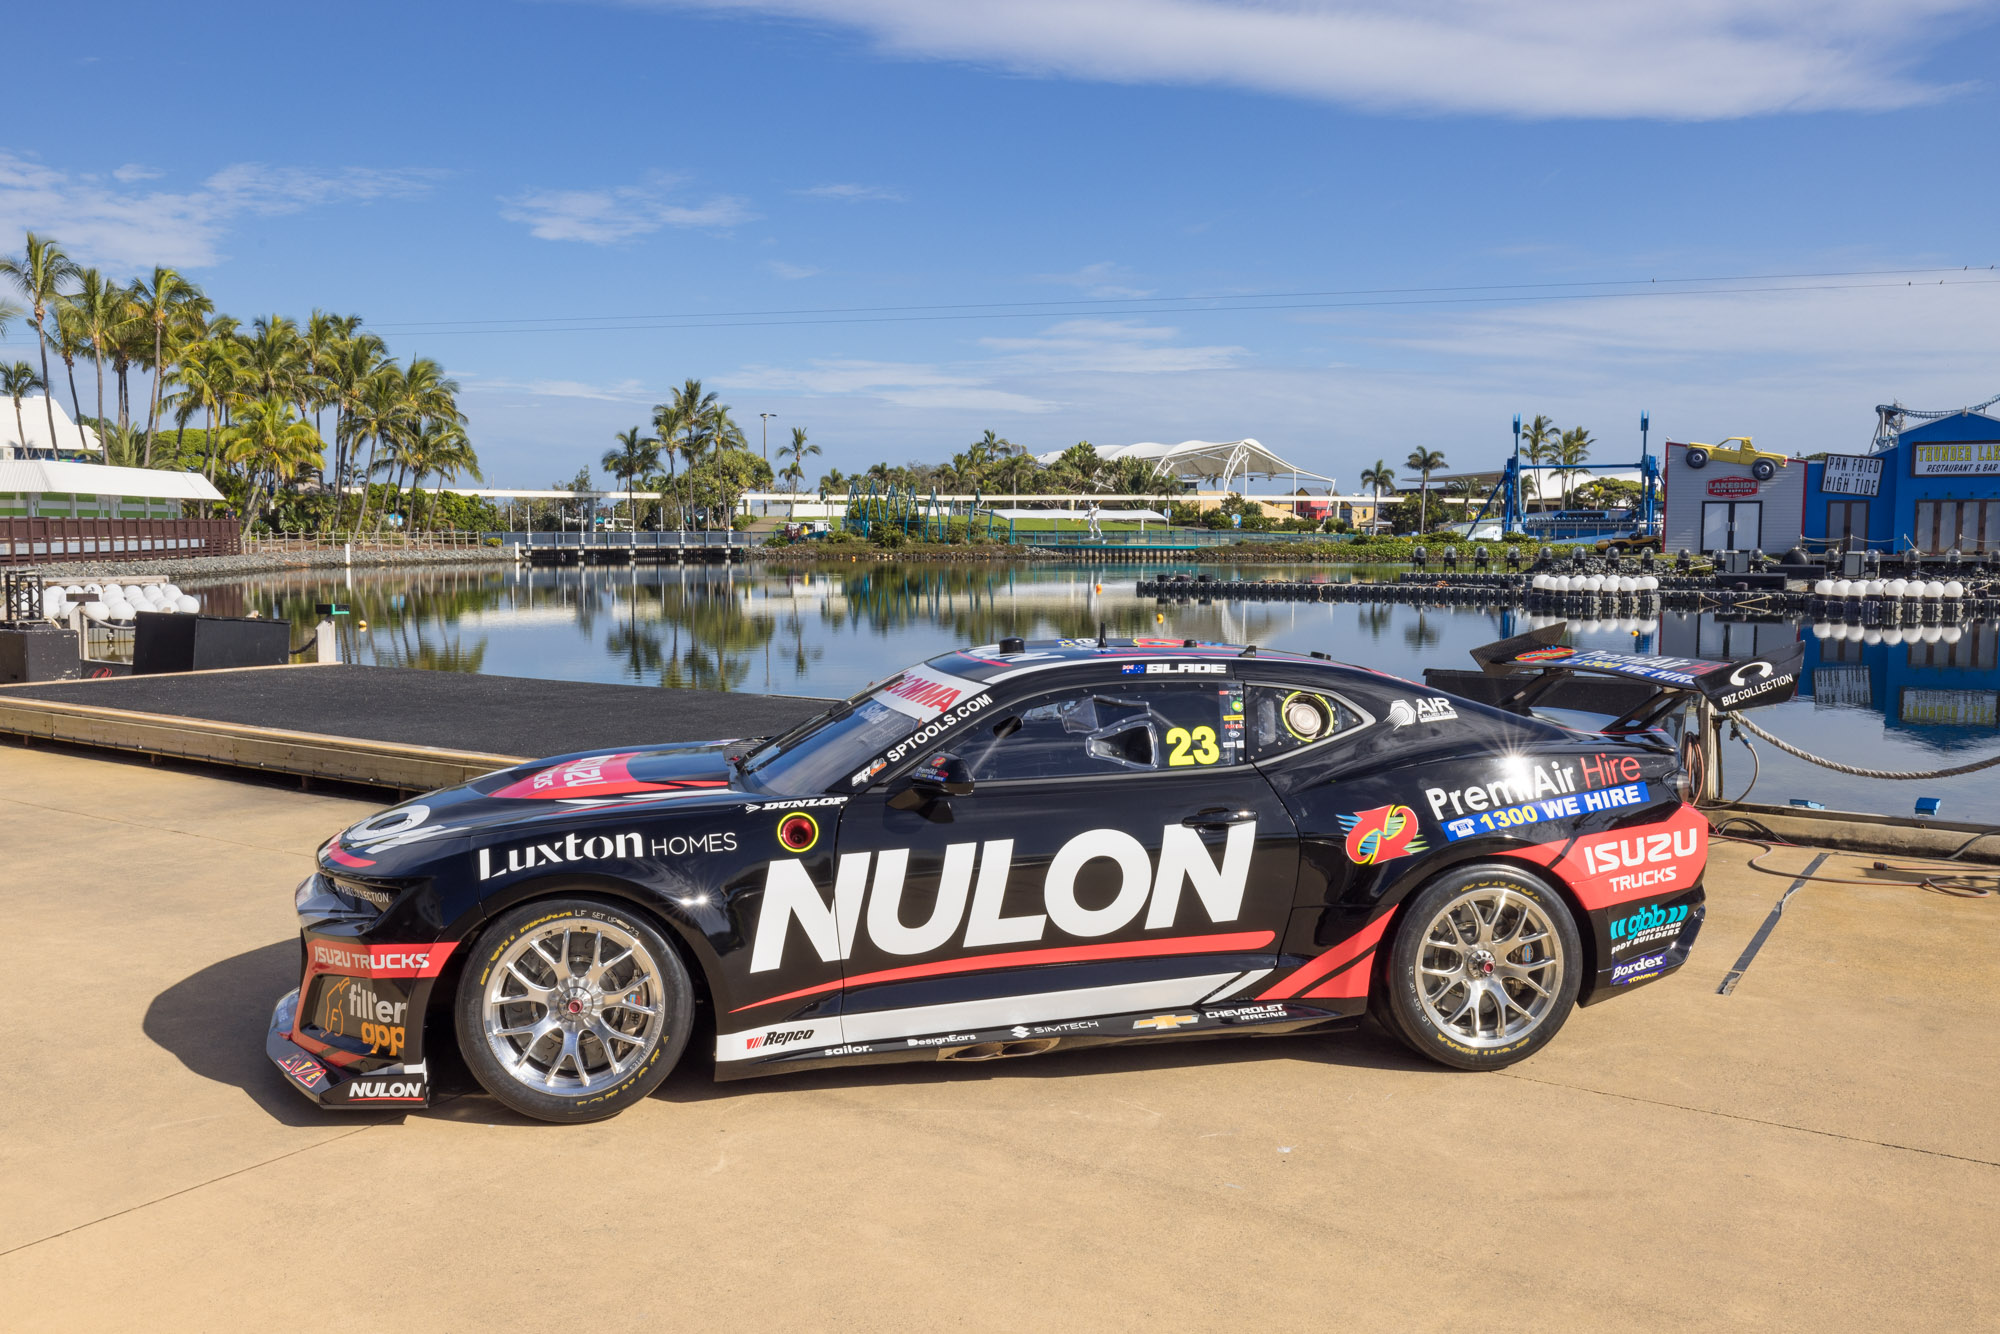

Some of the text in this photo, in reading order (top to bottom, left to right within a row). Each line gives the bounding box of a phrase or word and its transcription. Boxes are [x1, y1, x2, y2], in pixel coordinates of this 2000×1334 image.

[1918, 446, 1971, 462] THUNDER
[1829, 457, 1880, 473] PAN FRIED
[1927, 464, 1974, 473] RESTAURANT
[1983, 463, 1999, 472] BAR
[1709, 481, 1757, 489] LAKESIDE
[1825, 476, 1876, 495] HIGH TIDE
[1721, 673, 1794, 707] BIZ COLLECTION
[1416, 697, 1454, 714] AIR
[886, 693, 993, 762] SPTOOLS.COM
[1166, 725, 1220, 767] 23
[1580, 753, 1641, 790] Hire
[762, 797, 848, 810] DUNLOP
[1480, 785, 1641, 831] 1300 WE HIRE
[479, 832, 737, 881] Luxton HOMES
[1584, 828, 1698, 875] ISUZU
[1609, 866, 1677, 893] TRUCKS
[749, 820, 1257, 974] NULON
[575, 909, 640, 937] LF SET UP 23
[1637, 922, 1681, 937] GIPPSLAND
[1611, 928, 1681, 955] BODY BUILDERS
[314, 946, 430, 969] ISUZU TRUCKS
[1612, 955, 1664, 980] Border
[1205, 1003, 1284, 1019] CHEVROLET
[1240, 1010, 1287, 1022] RACING
[1034, 1021, 1099, 1034] SIMTECH
[361, 1021, 405, 1056] app
[763, 1029, 815, 1046] Repco
[907, 1033, 977, 1046] DesignEars
[824, 1045, 873, 1056] sailor.
[349, 1082, 422, 1098] NULON
